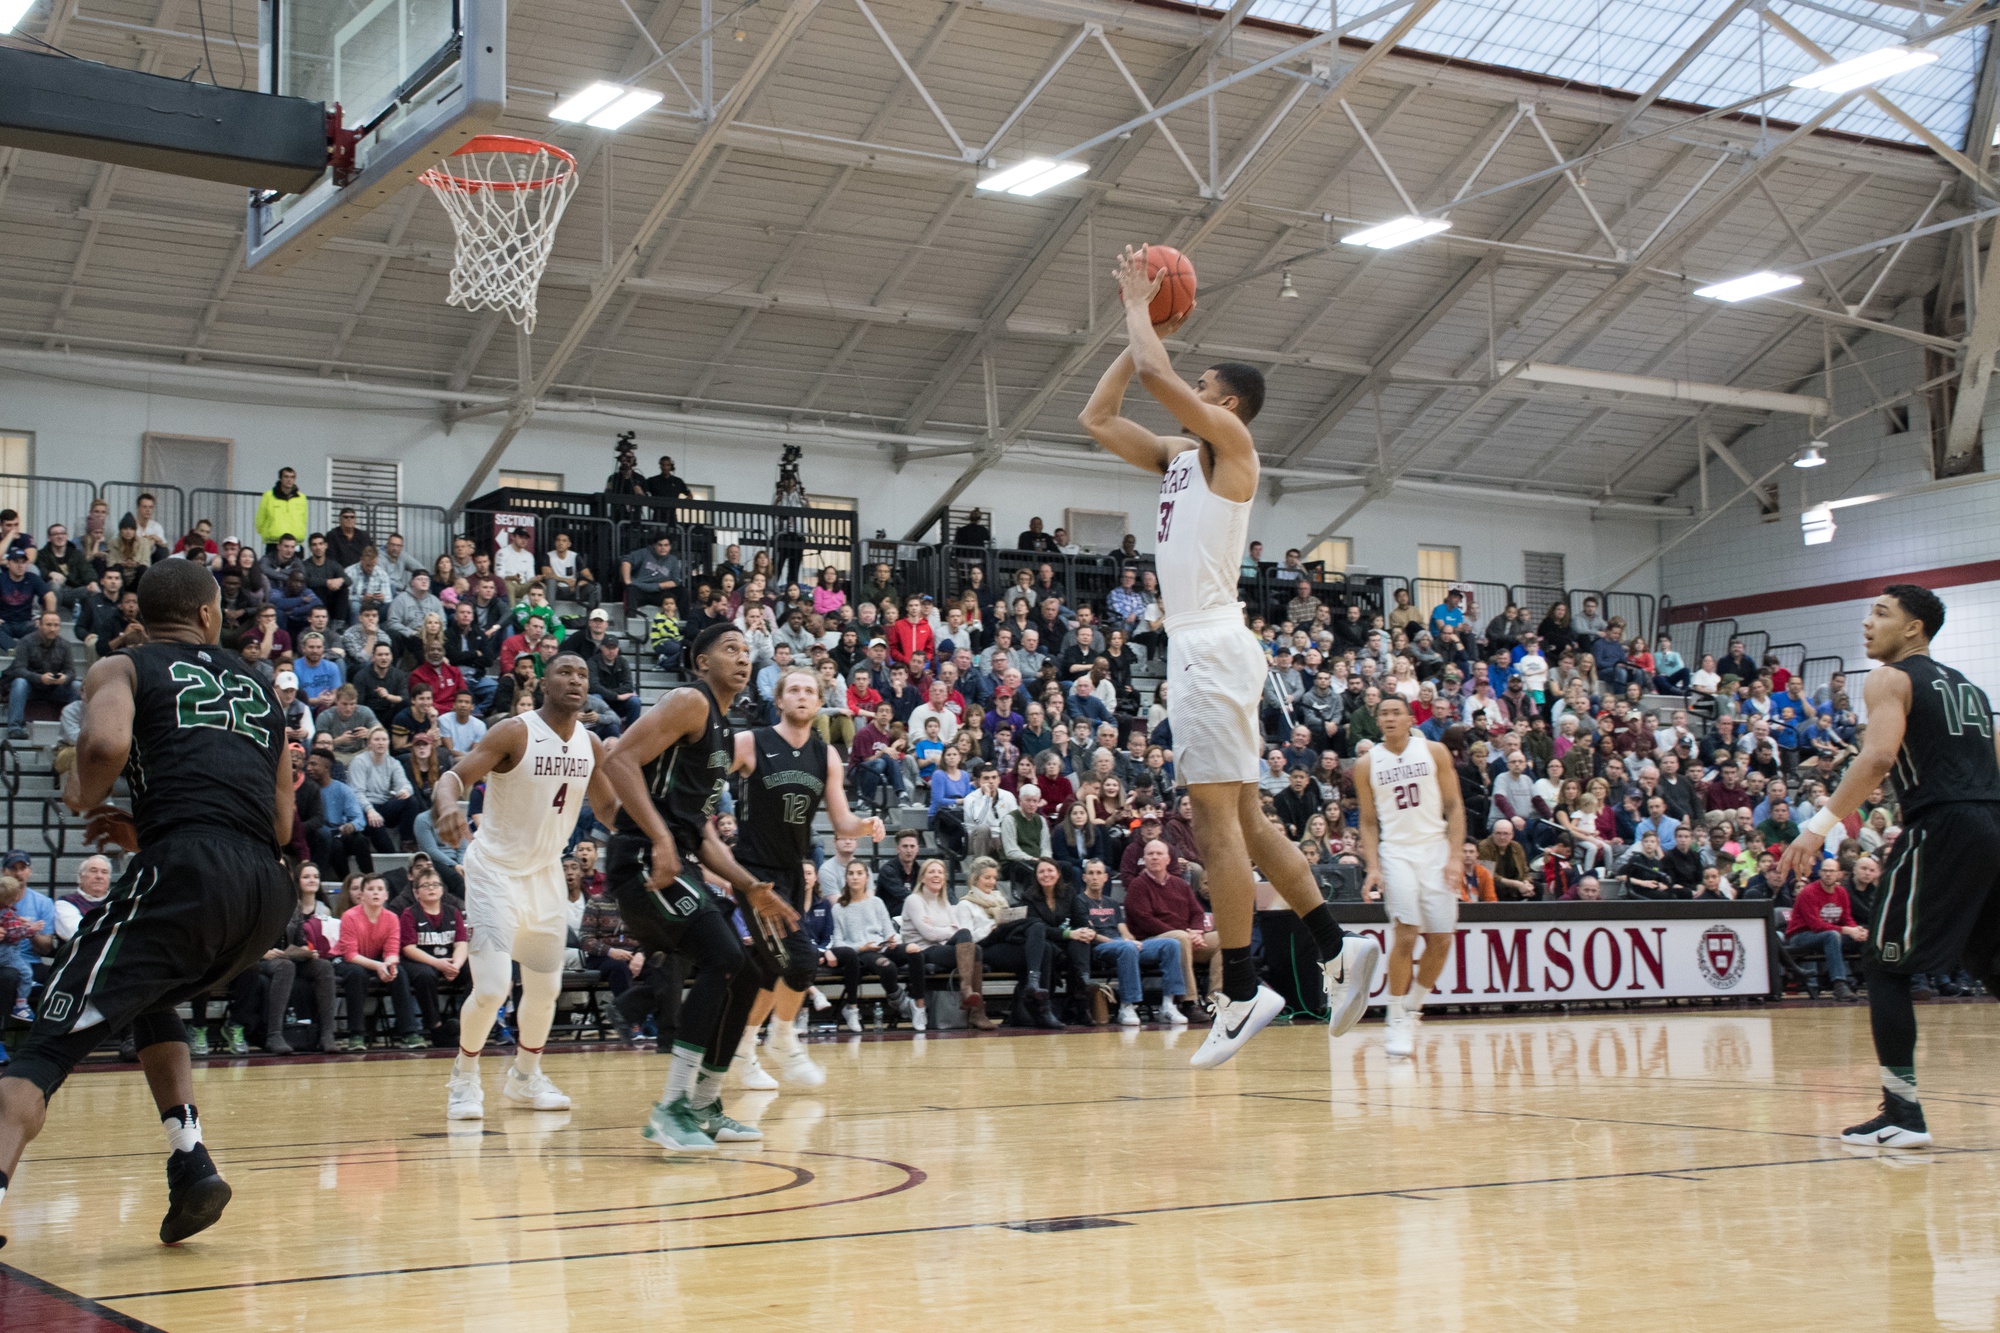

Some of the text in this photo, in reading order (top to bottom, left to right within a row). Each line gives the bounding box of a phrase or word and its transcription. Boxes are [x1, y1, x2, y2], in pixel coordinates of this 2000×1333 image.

[495, 513, 535, 527] SECTION
[168, 661, 271, 748] 22
[1931, 679, 1991, 738] 14
[534, 756, 588, 777] HARVARD
[1377, 762, 1429, 786] HARVARD
[552, 783, 568, 814] 4
[782, 793, 811, 824] 12
[1393, 783, 1419, 810] 20
[674, 896, 699, 916] D
[1360, 928, 1667, 997] CIMSON
[1882, 941, 1901, 962] D
[44, 991, 74, 1022] D
